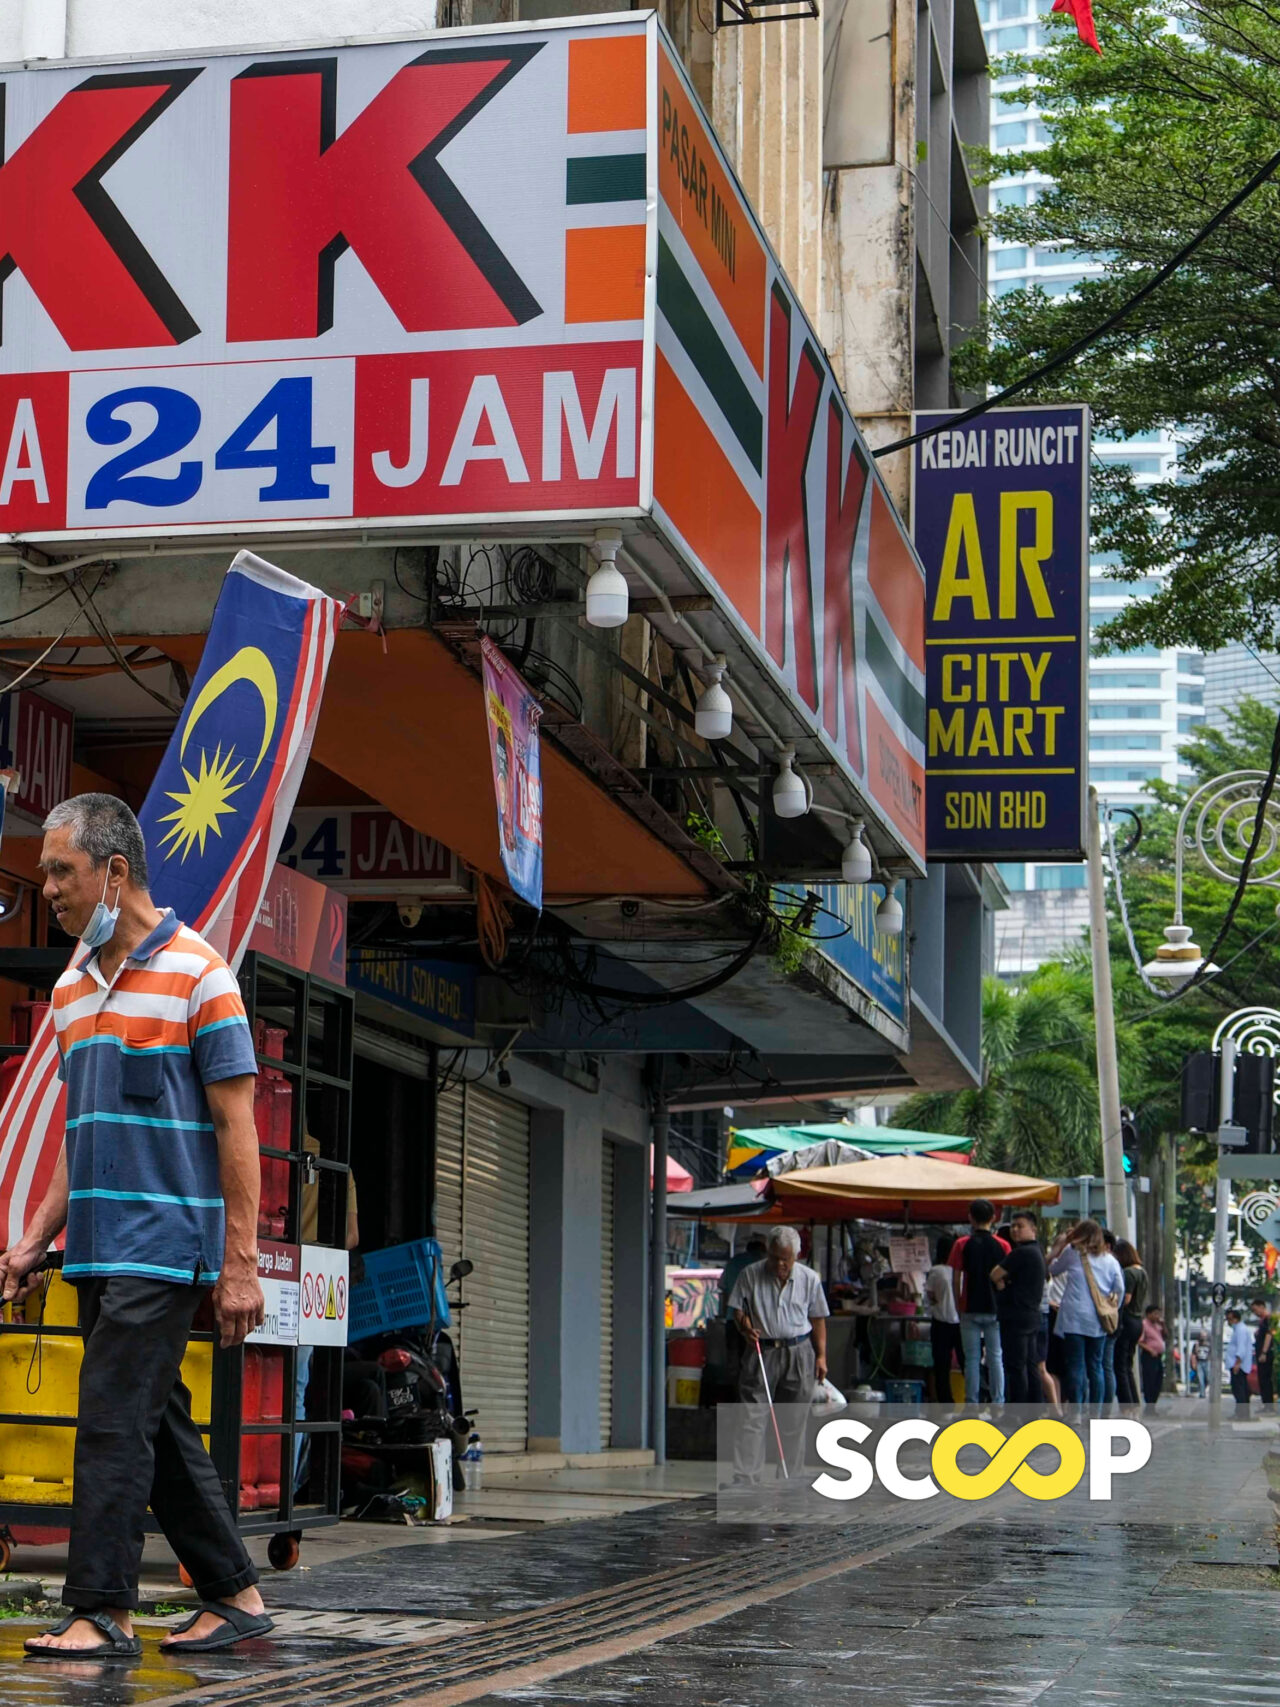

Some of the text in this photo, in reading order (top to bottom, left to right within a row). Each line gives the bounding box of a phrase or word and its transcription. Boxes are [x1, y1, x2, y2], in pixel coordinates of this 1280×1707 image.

[662, 85, 736, 284] PASAR MINI
[84, 376, 336, 510] 24
[371, 367, 637, 488] JAM
[921, 425, 1079, 469] KEDAI RUNCIT
[765, 278, 869, 783] KK
[932, 490, 1055, 621] AR
[942, 652, 1052, 702] CITY
[20, 703, 69, 813] JAM
[928, 706, 1065, 757] MART
[945, 791, 1046, 829] SDN BHD
[357, 820, 444, 872] JAM
[411, 965, 435, 1010] SDN
[438, 976, 461, 1020] BHD
[274, 1251, 293, 1272] Jualan
